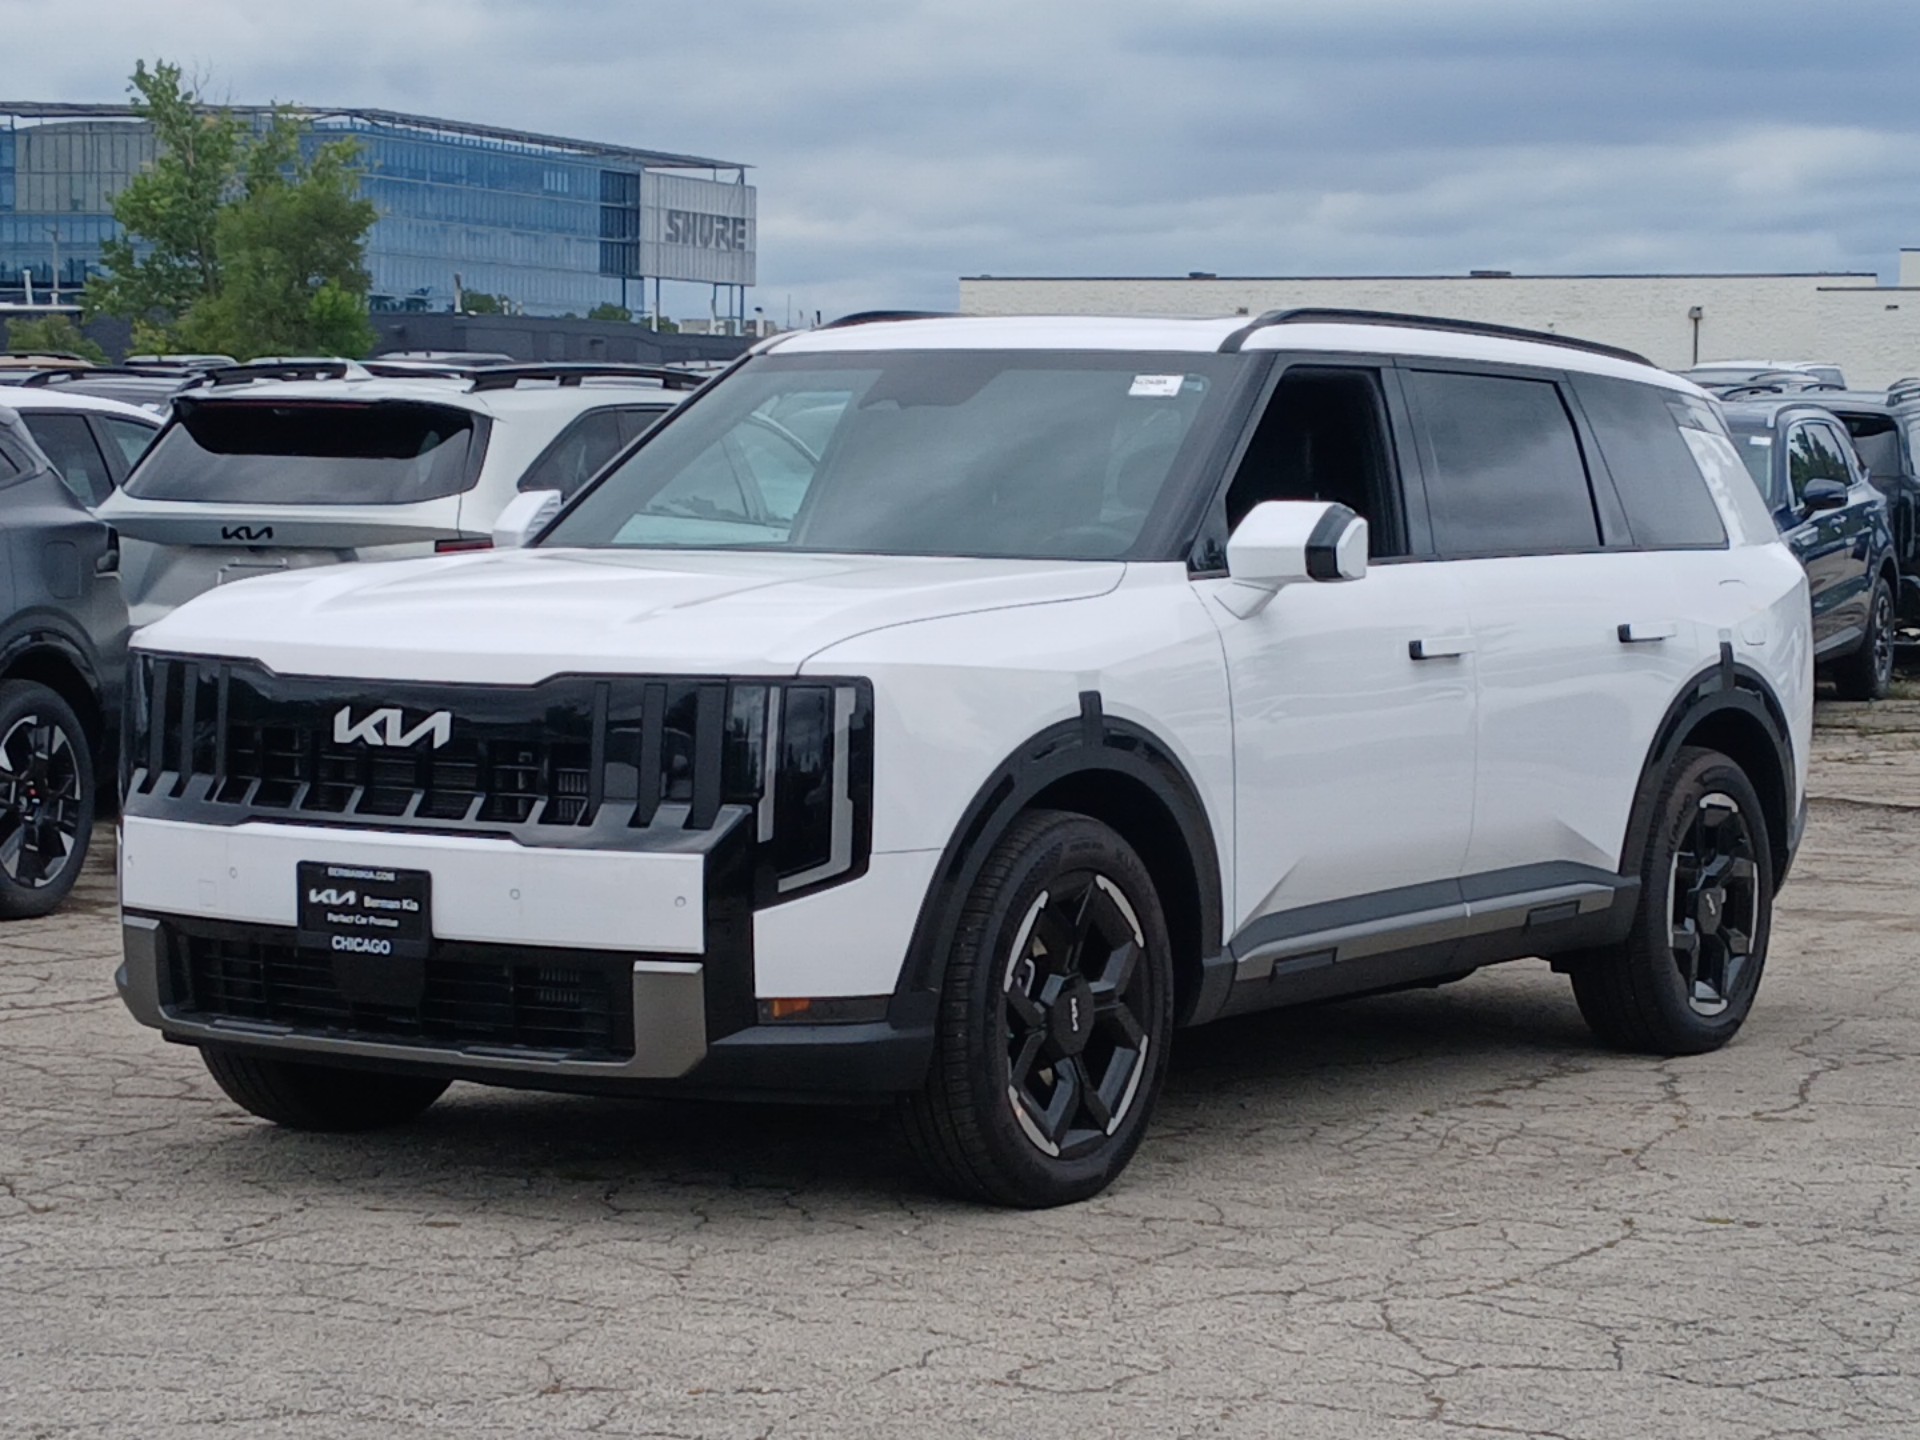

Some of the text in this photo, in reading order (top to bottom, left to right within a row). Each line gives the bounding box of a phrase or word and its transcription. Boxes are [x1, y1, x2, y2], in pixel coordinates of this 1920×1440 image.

[665, 209, 746, 252] SHURE
[221, 526, 273, 540] KIA
[334, 705, 451, 749] KIA
[309, 888, 356, 905] KIA
[331, 935, 391, 955] CHICAGO
